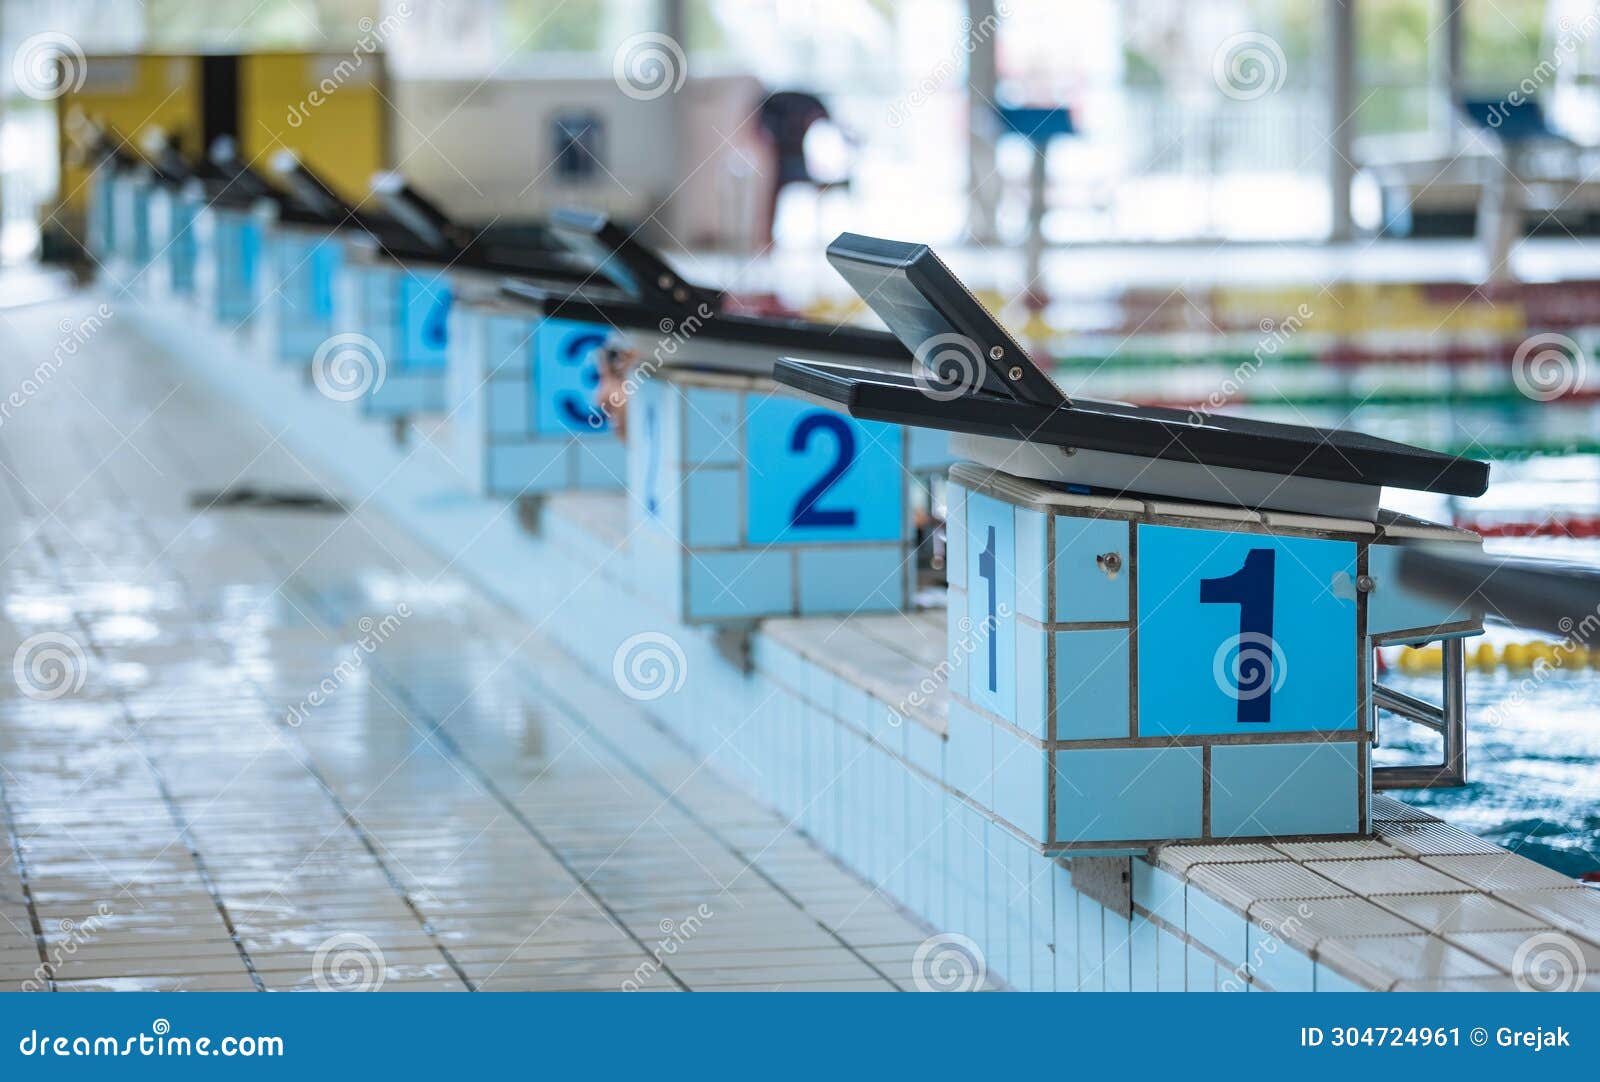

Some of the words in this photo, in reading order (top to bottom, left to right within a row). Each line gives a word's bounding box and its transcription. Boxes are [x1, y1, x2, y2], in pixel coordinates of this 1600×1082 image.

[560, 331, 609, 431] 3
[789, 412, 858, 528] 2
[979, 525, 997, 693] 1
[1199, 548, 1276, 723] 1
